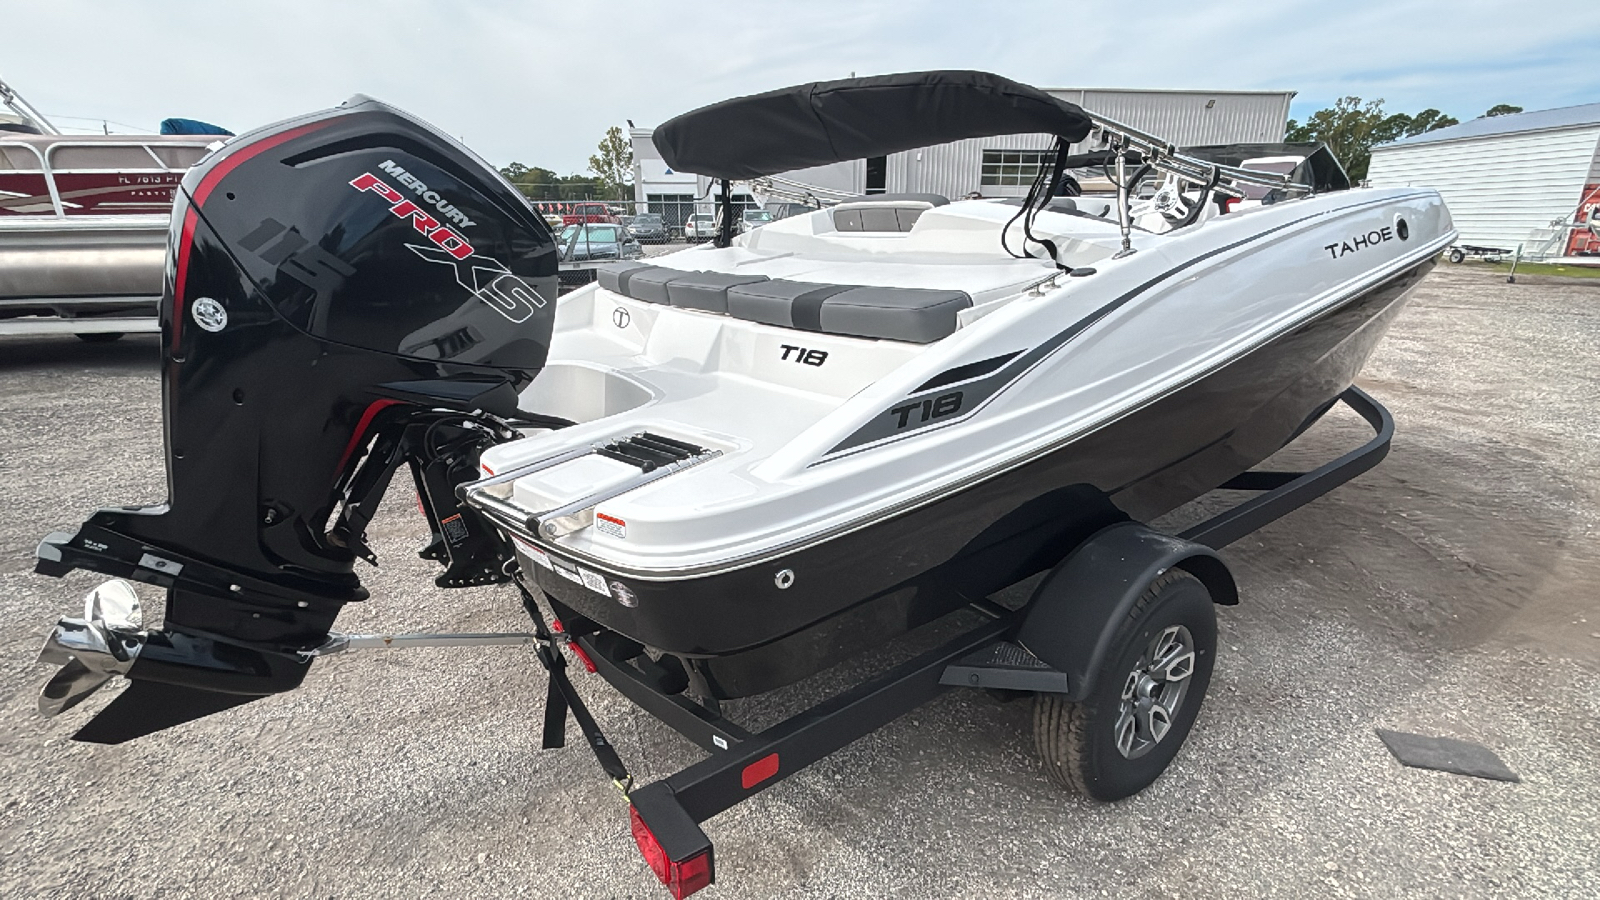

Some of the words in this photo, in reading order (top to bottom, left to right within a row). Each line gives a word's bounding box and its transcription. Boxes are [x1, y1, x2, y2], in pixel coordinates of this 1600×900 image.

[118, 175, 131, 184] FL
[378, 160, 477, 228] MERCURY
[349, 172, 475, 260] PRO
[1324, 226, 1393, 259] TAHOE
[404, 223, 547, 323] XS
[780, 344, 829, 367] T18
[891, 391, 963, 429] T18
